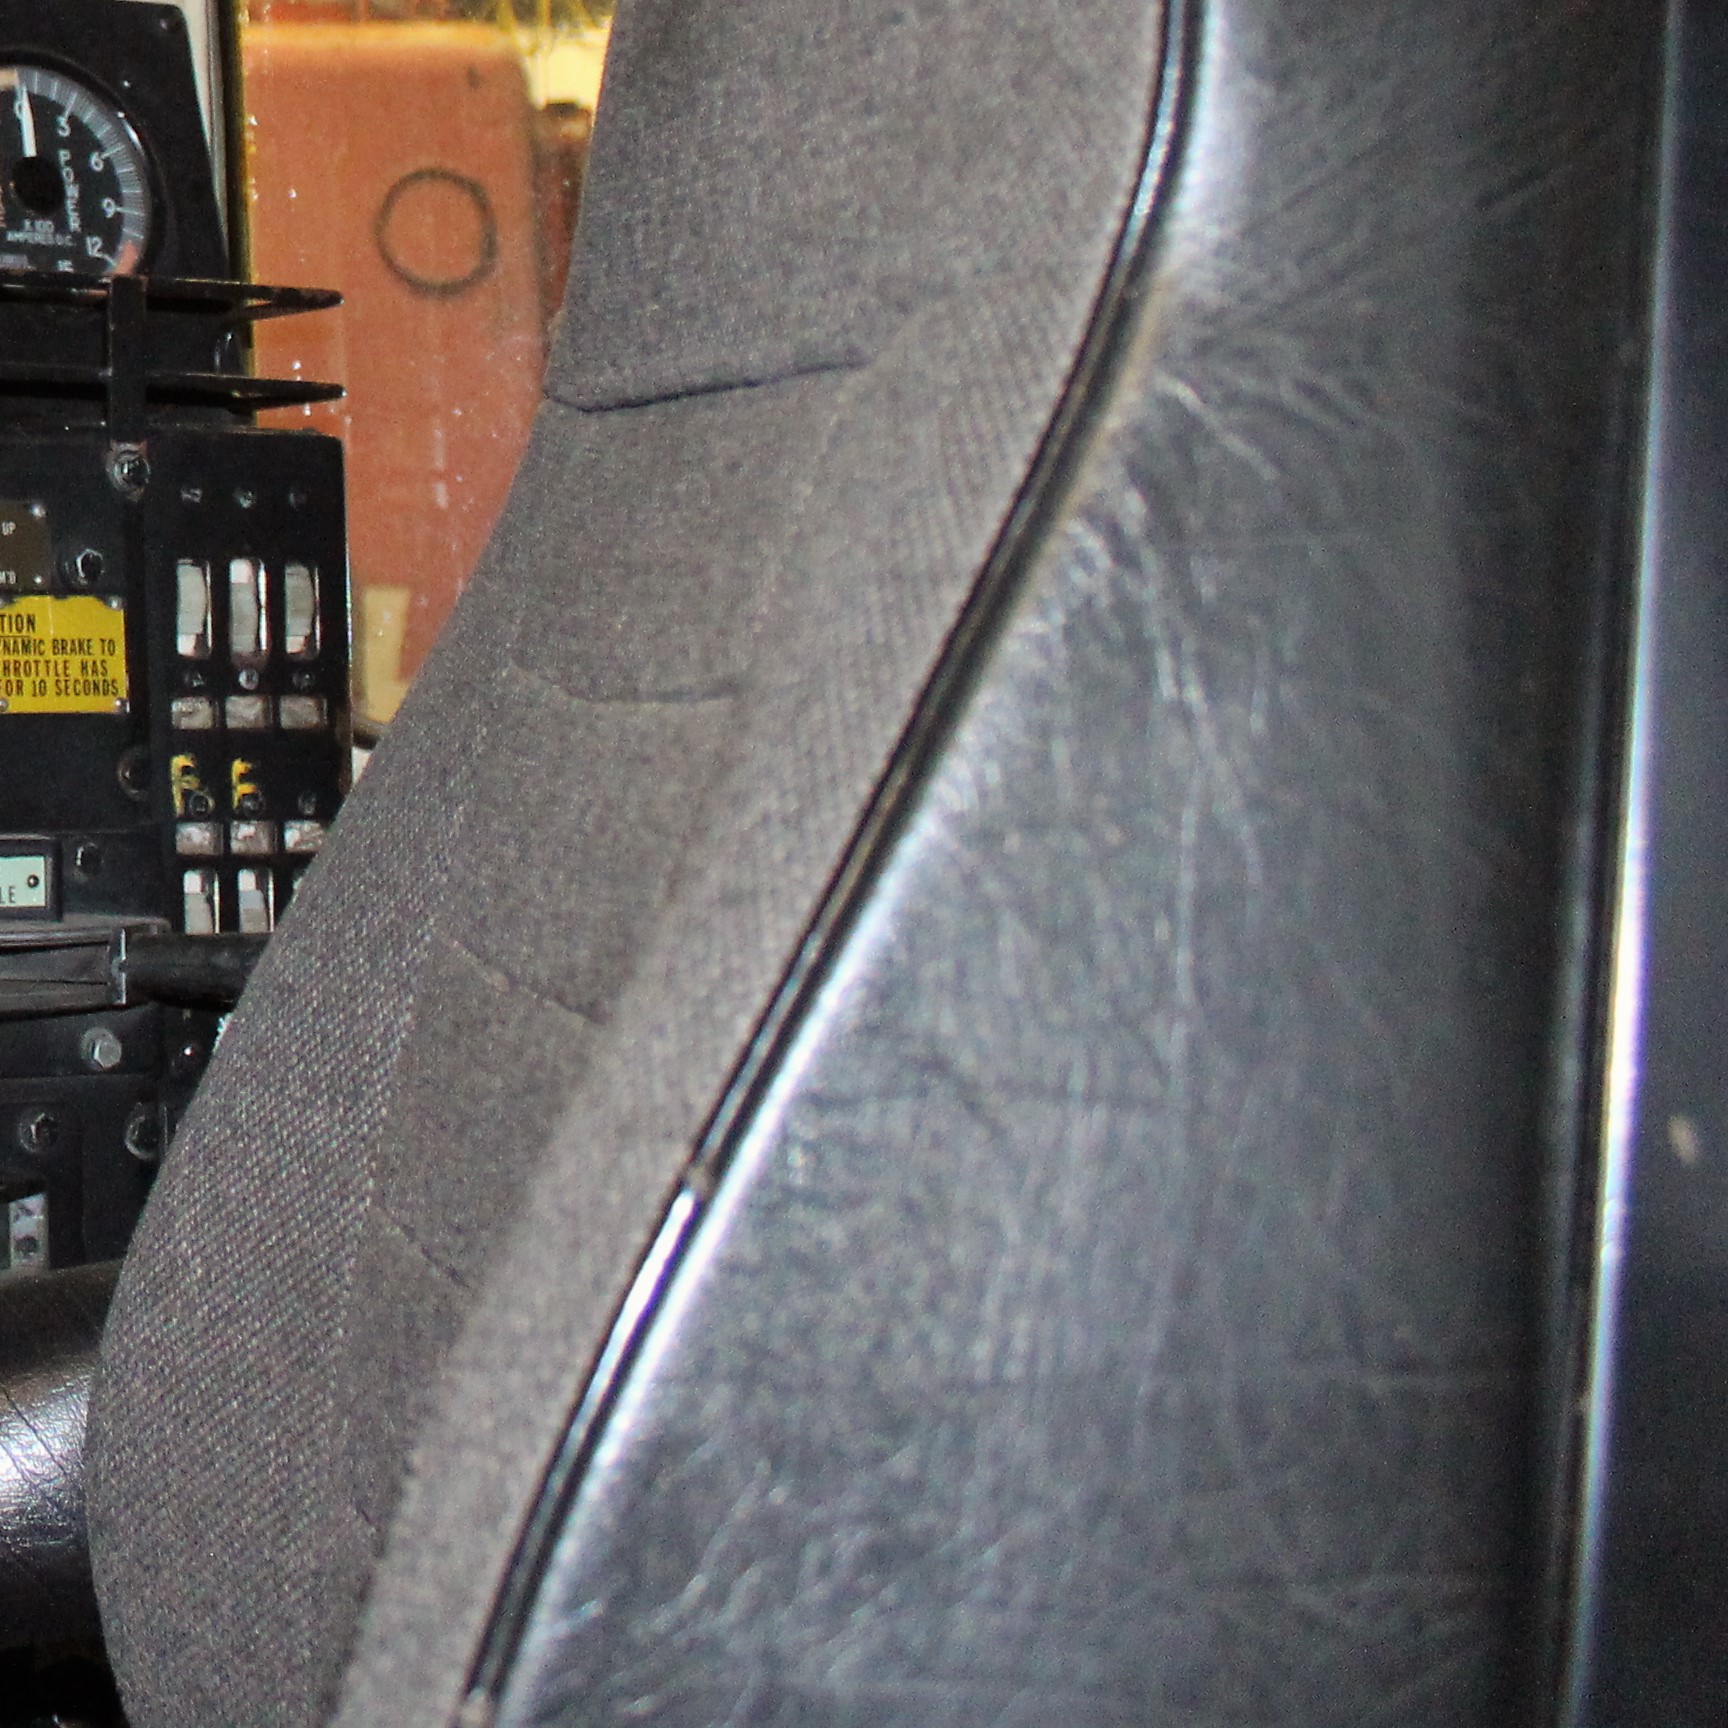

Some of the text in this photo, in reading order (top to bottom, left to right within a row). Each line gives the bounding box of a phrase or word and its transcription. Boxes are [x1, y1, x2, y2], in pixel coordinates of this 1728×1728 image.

[91, 152, 103, 172] 6
[103, 198, 115, 218] 9
[86, 236, 103, 257] 12
[2, 521, 16, 536] UP
[52, 639, 93, 656] BRAKE
[100, 639, 116, 656] TO
[81, 660, 108, 677] HAS
[32, 680, 46, 697] 10
[55, 680, 118, 697] SECONDS
